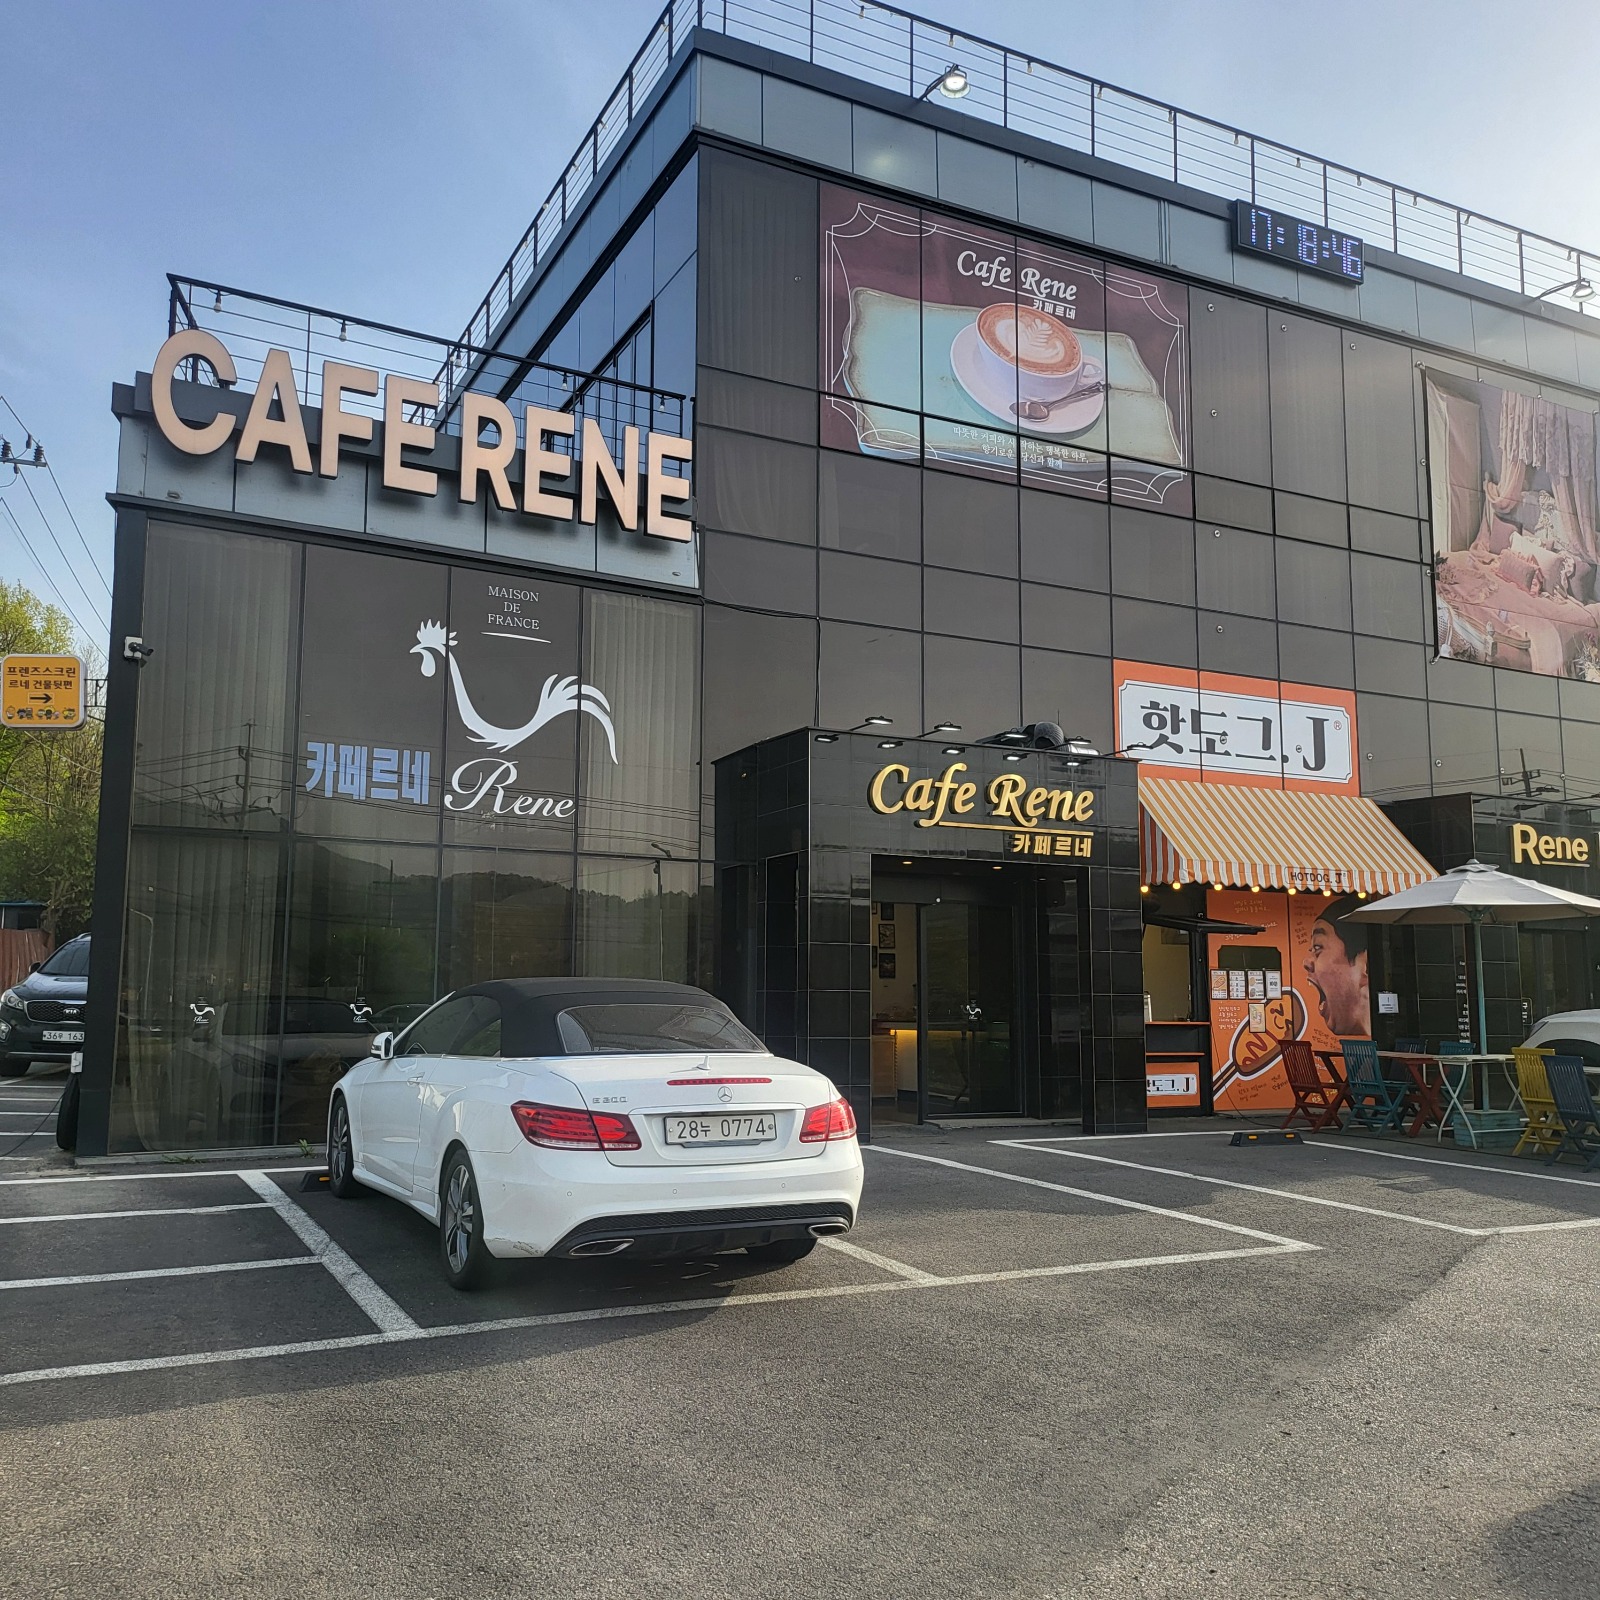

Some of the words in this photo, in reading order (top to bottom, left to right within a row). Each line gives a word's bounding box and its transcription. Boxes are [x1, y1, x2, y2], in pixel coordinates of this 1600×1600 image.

[957, 250, 1012, 287] Cafe
[1020, 267, 1077, 300] Rene
[1032, 299, 1076, 320] 카페르네
[152, 329, 439, 496] CAFE
[458, 392, 693, 543] RENE
[953, 427, 978, 440] 따뜻한
[981, 432, 1005, 446] 커피와
[1020, 452, 1044, 465] 당신과
[488, 585, 539, 602] MAISON
[503, 601, 521, 614] DE
[487, 613, 540, 630] FRANCE
[6, 666, 76, 678] 프렌즈스크린
[8, 680, 30, 690] 르네
[305, 741, 430, 805] 카페르네
[444, 758, 576, 818] Rene
[871, 762, 977, 828] Cafe
[989, 773, 1094, 827] Rene
[1013, 833, 1092, 858] 카페르네
[1512, 822, 1589, 866] Rene
[676, 1120, 711, 1139] 28누
[720, 1118, 766, 1137] 0774
